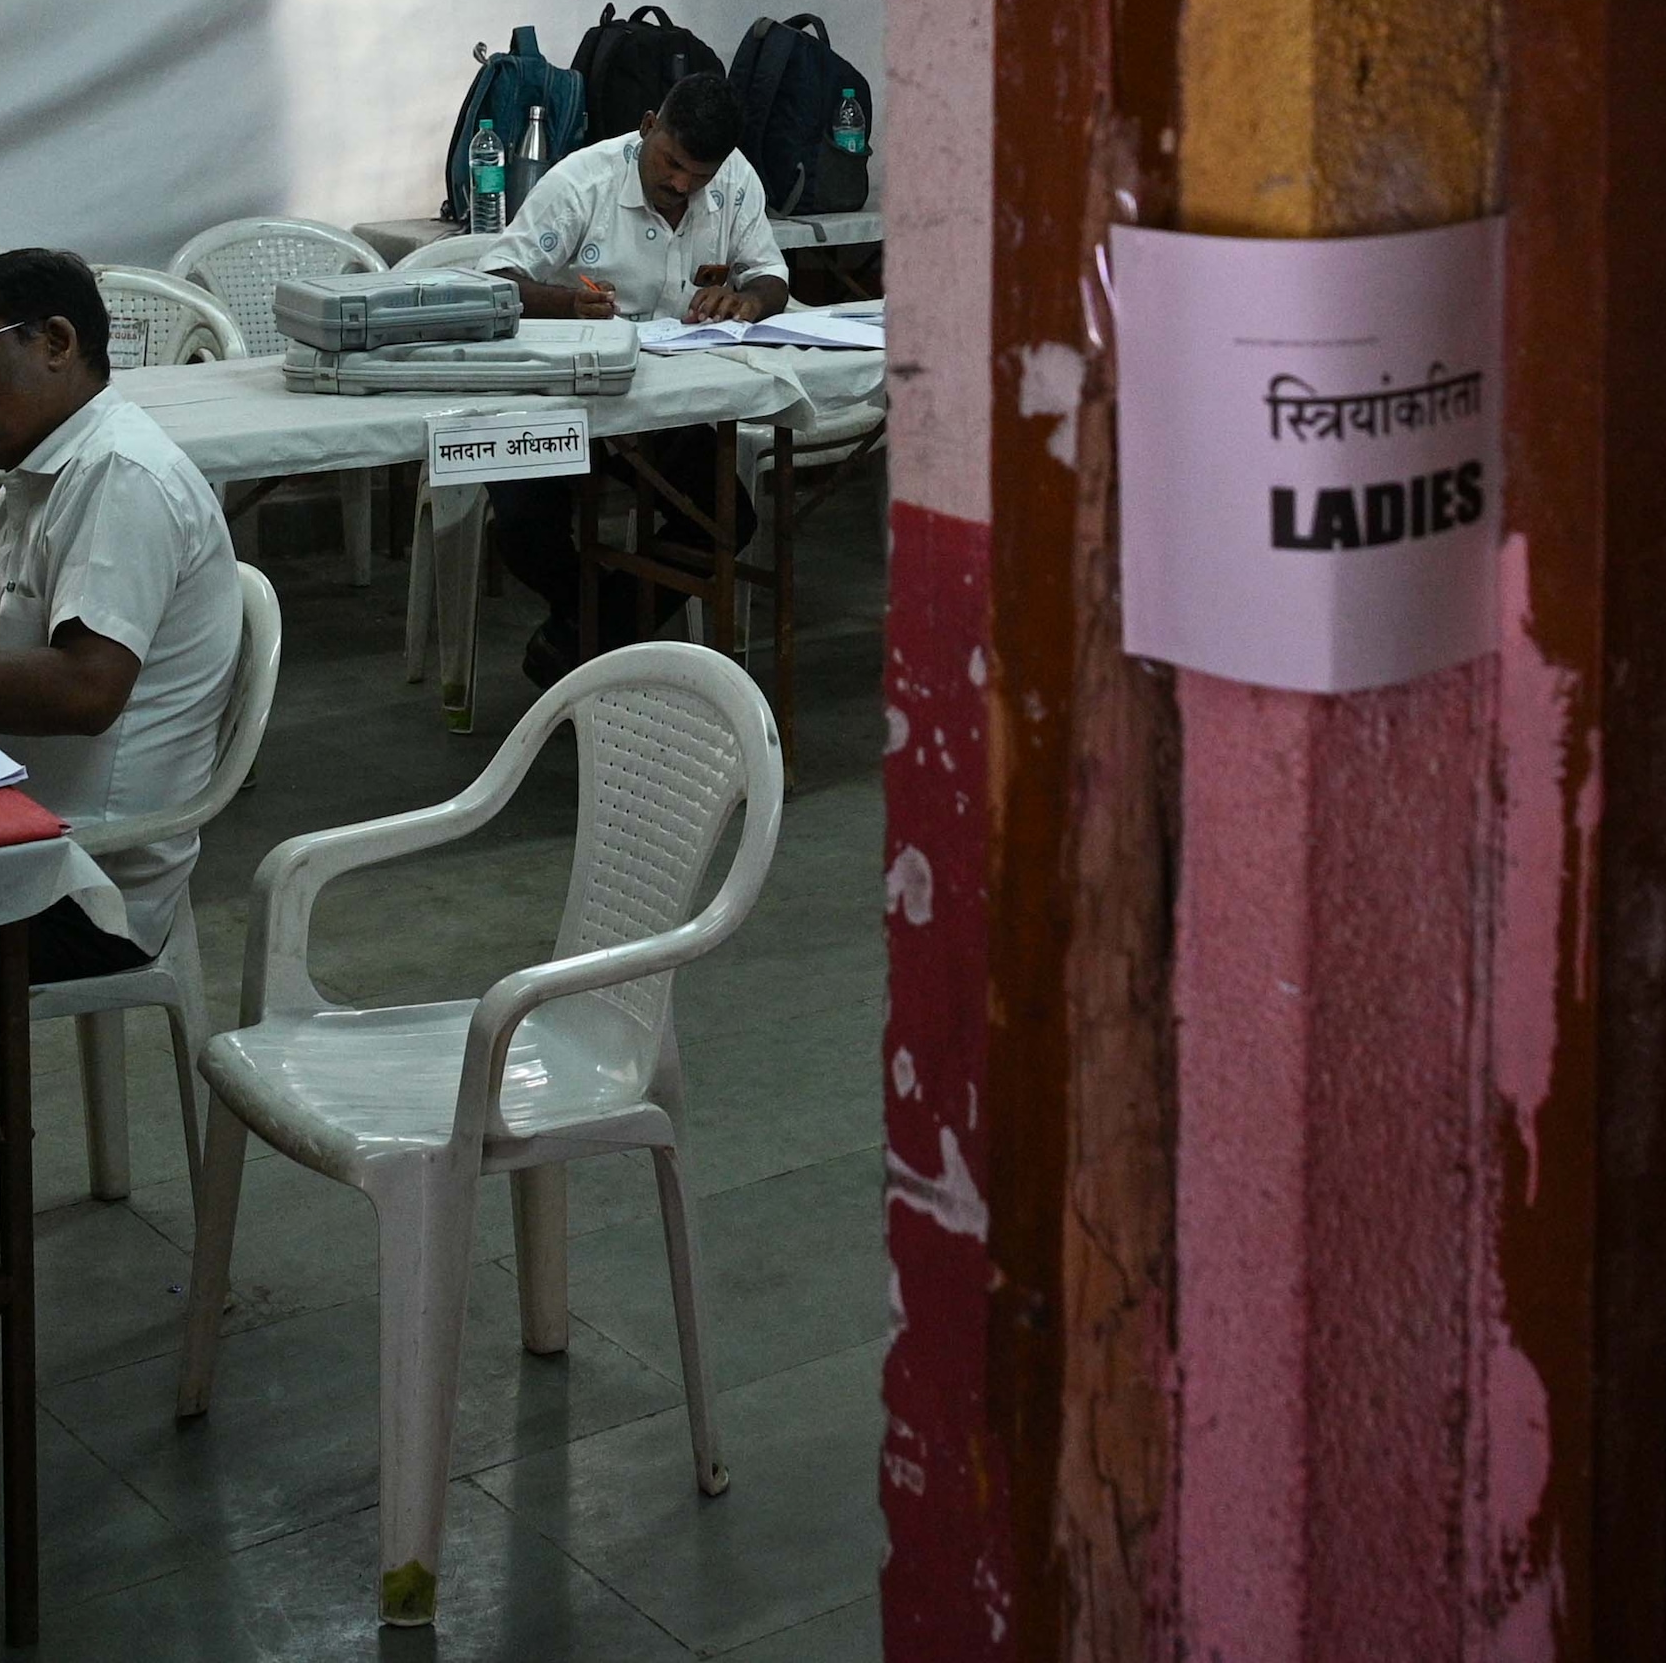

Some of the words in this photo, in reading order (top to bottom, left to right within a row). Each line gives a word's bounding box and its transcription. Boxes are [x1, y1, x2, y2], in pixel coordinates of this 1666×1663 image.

[439, 441, 497, 462] मतदान
[506, 427, 579, 456] अधिकारी
[1271, 460, 1484, 550] LADIES
